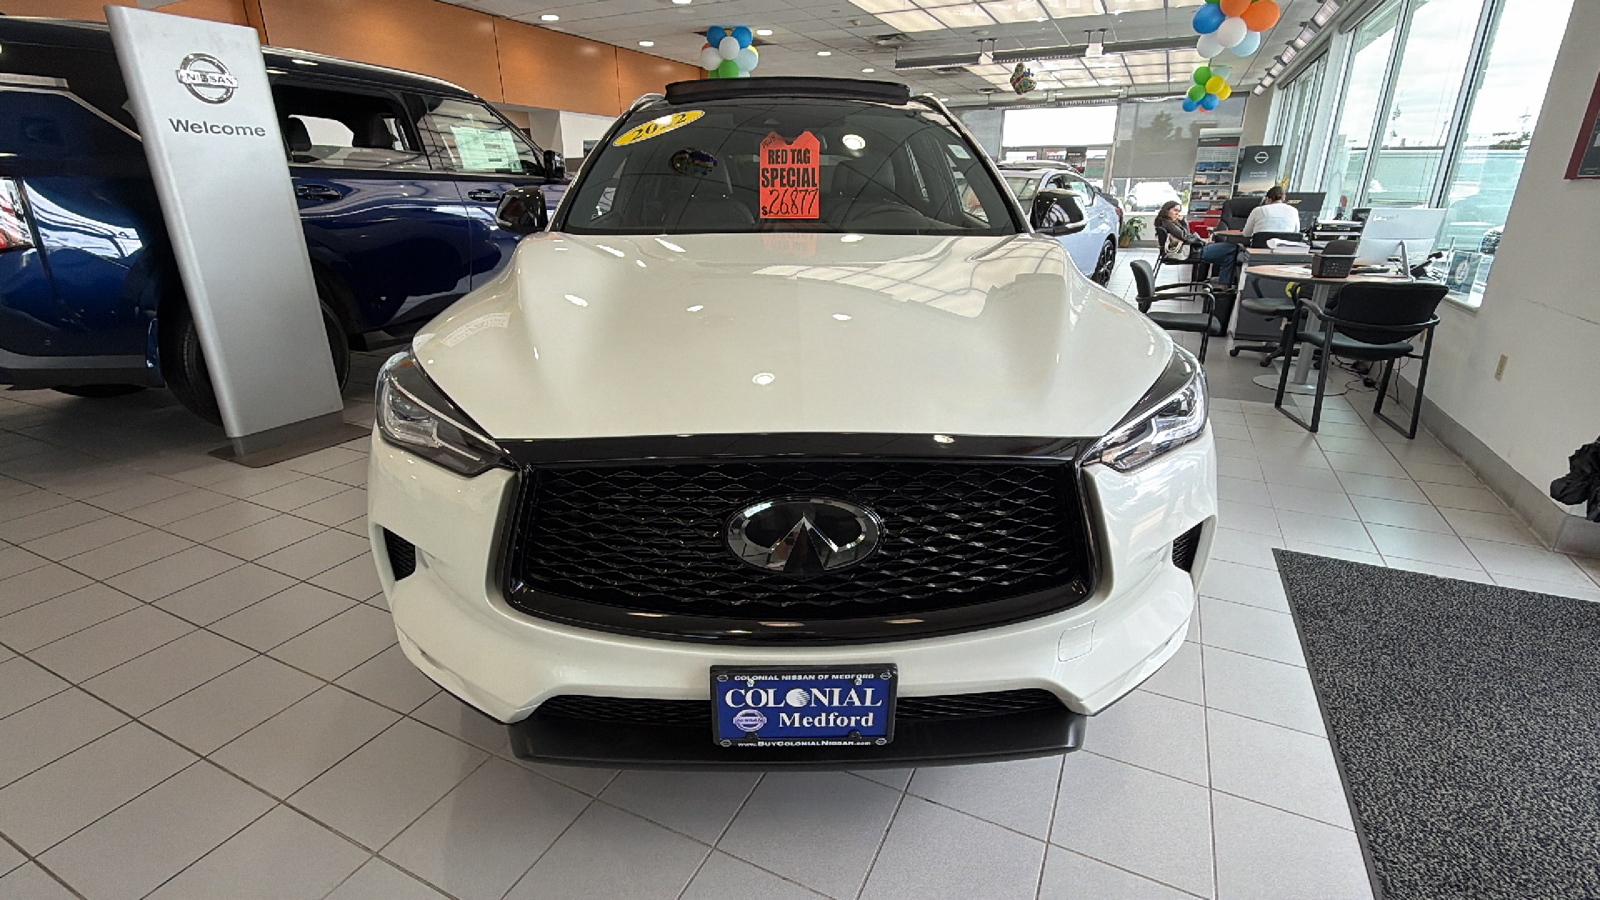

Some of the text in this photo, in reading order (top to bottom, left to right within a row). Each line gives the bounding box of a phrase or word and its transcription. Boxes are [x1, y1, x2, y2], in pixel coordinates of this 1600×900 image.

[186, 72, 236, 86] NISSAN
[168, 118, 266, 137] Welcome
[768, 148, 811, 165] RED TAG
[761, 167, 818, 188] SPECIAL
[725, 687, 882, 708] COLONIAL
[778, 711, 874, 728] Medford
